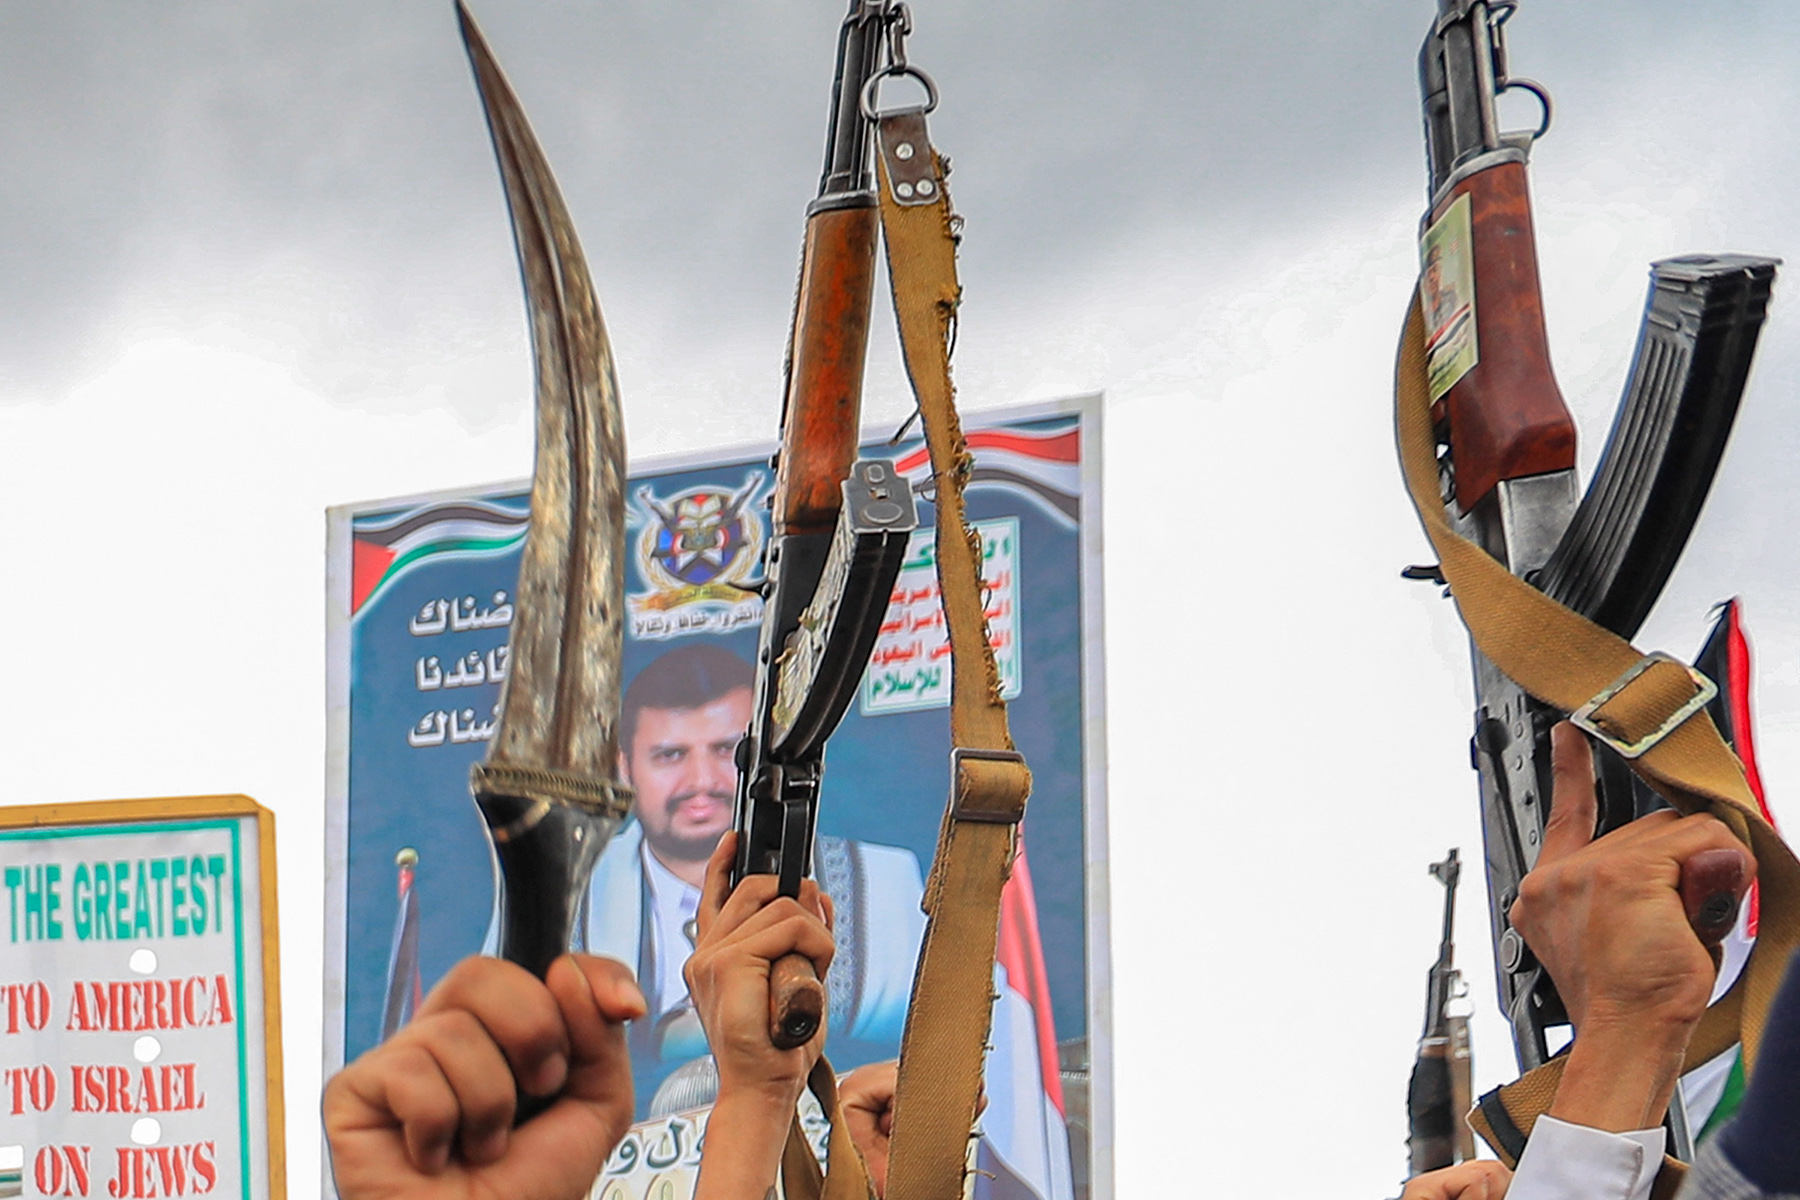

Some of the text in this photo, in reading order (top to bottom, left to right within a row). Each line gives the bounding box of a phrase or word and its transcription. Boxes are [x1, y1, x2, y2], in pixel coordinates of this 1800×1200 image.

[4, 862, 63, 944] THE
[73, 853, 227, 941] GREATEST
[0, 980, 51, 1035] TO
[66, 974, 235, 1032] AMERICA
[4, 1064, 57, 1116] TO
[71, 1062, 206, 1114] ISRAEL
[33, 1144, 92, 1199] ON
[108, 1140, 218, 1200] JEWS
